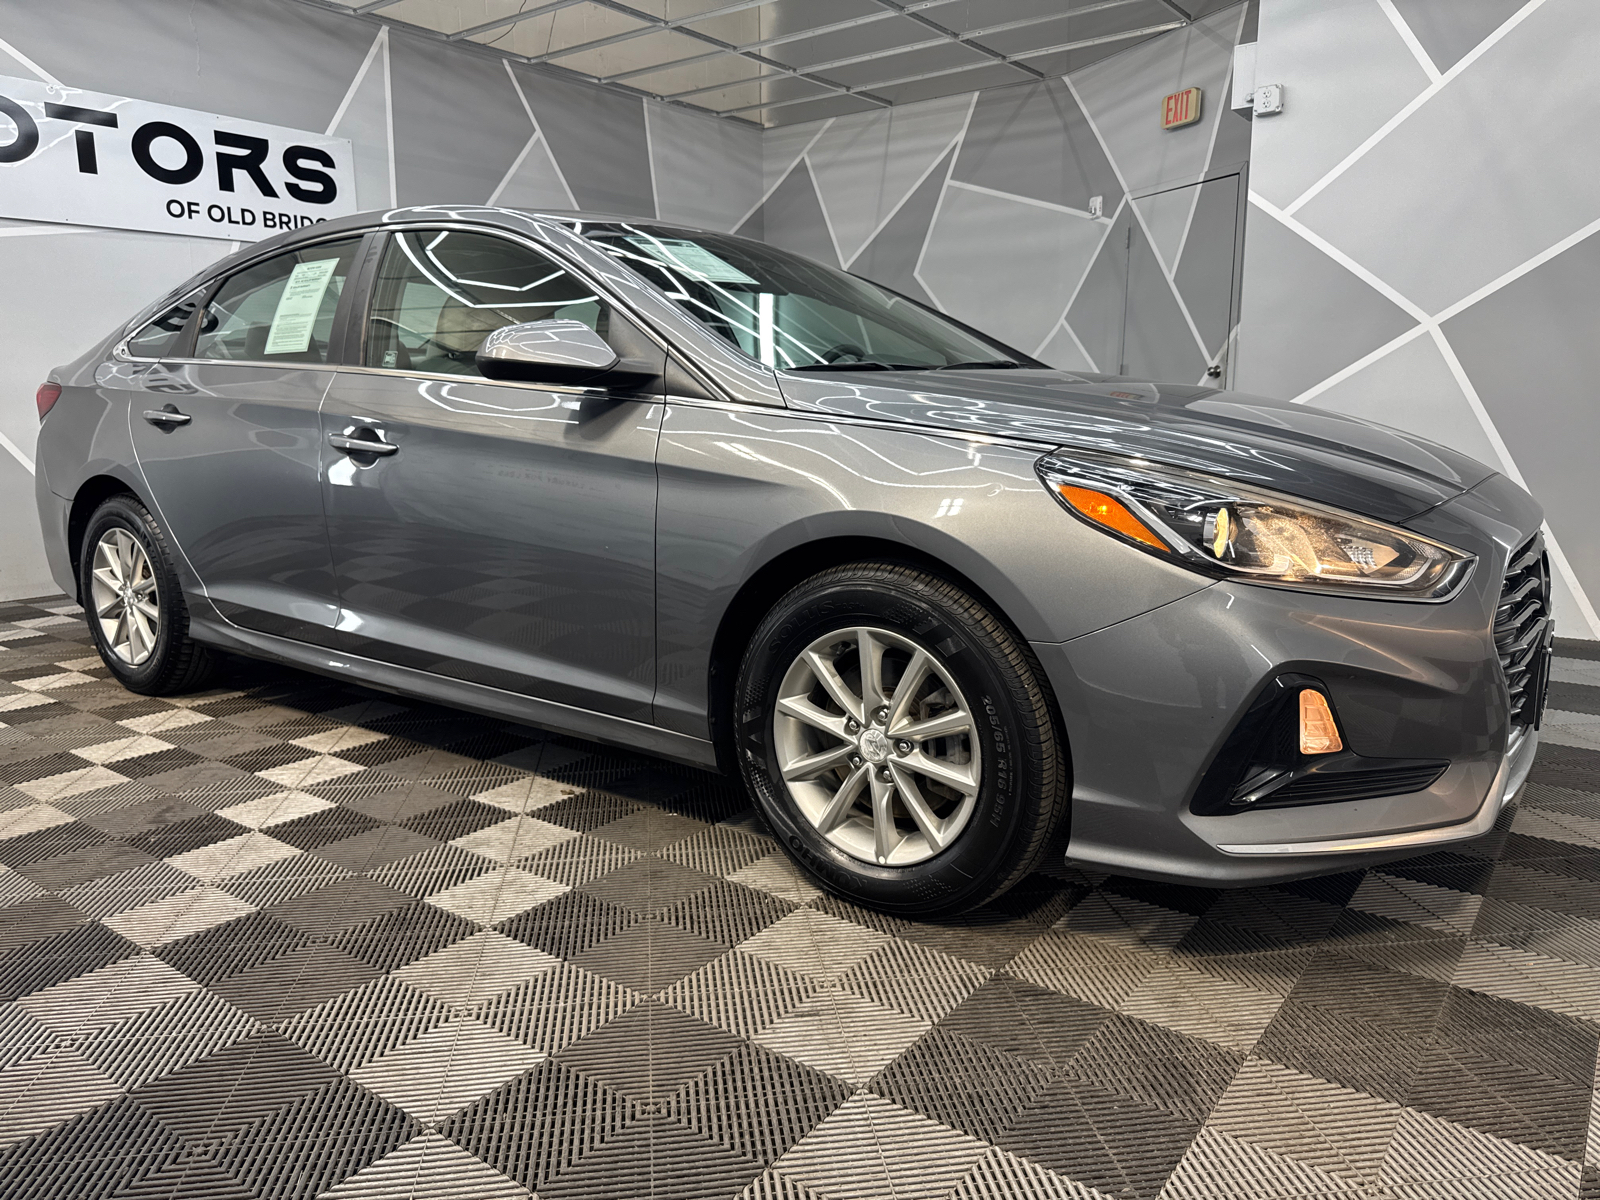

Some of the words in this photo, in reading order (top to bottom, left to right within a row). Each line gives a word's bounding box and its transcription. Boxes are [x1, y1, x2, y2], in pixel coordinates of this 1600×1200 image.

[1165, 90, 1192, 126] EXIT
[166, 199, 200, 220] OF
[207, 204, 257, 226] OLD
[981, 694, 1006, 753] 205/65
[997, 759, 1008, 790] R16
